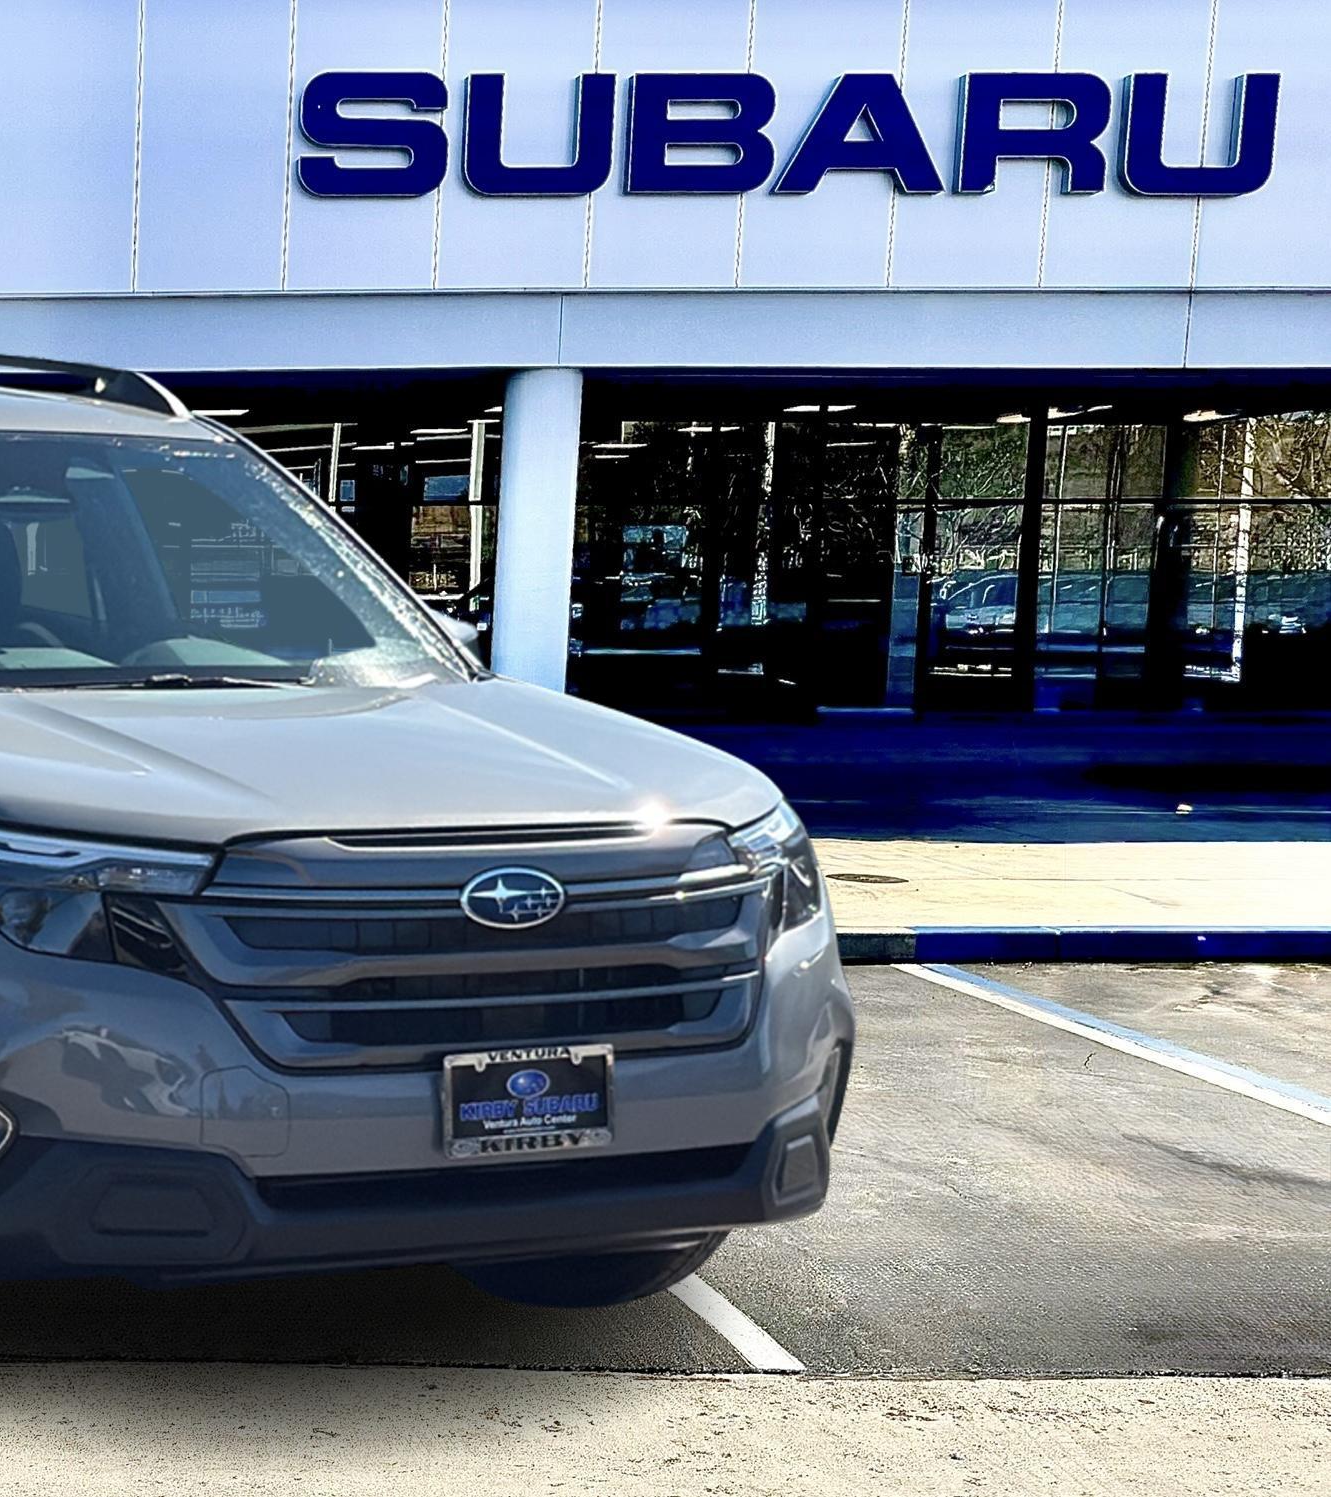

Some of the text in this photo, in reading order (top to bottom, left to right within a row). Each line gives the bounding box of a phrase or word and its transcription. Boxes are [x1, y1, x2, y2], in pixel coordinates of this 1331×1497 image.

[296, 70, 1282, 198] SUBARU
[487, 1046, 571, 1063] VENTURA
[460, 1093, 599, 1121] KIRBY SUBARU
[482, 1118, 518, 1130] Ventura
[519, 1115, 543, 1127] Auto
[544, 1112, 577, 1125] Center
[479, 1131, 584, 1154] KIRBY
